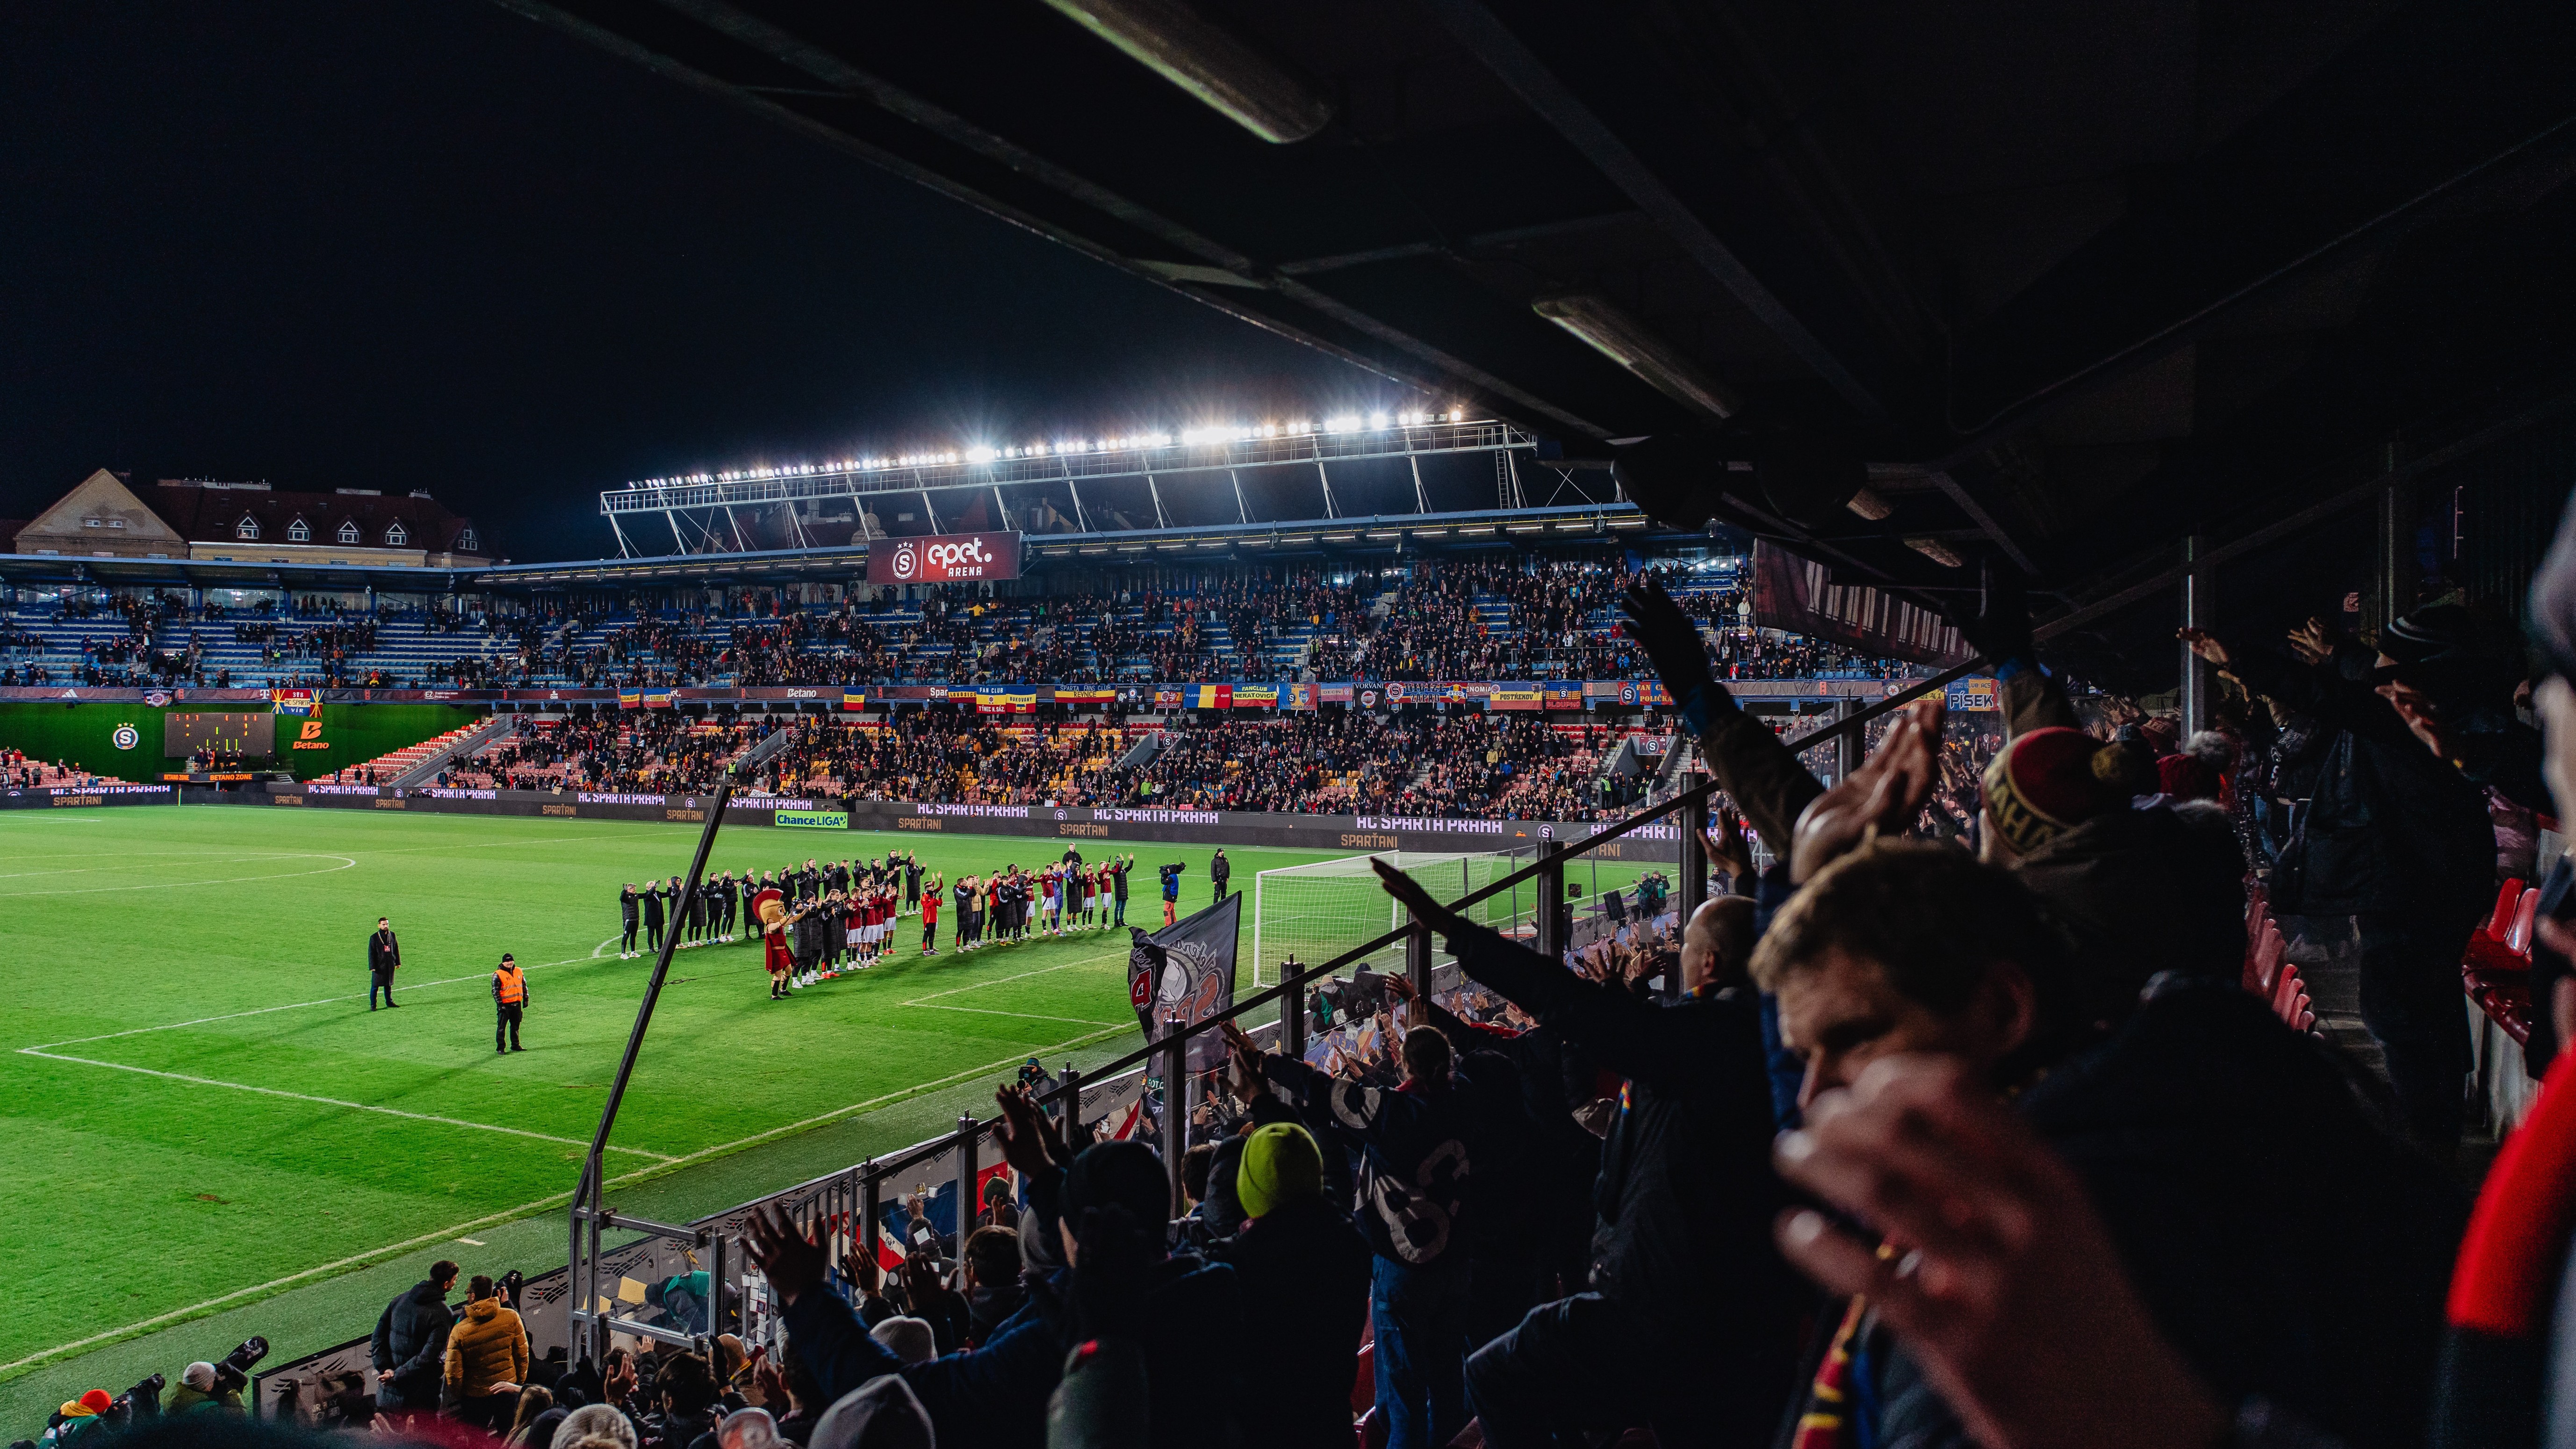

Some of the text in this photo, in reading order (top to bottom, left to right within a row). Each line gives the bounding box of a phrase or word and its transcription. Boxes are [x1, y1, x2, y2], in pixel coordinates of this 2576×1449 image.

[948, 566, 982, 577] ARENA
[787, 688, 817, 698] Betano
[1404, 683, 1446, 693] DIVIZE
[1410, 692, 1440, 702] ZÁPAD
[1950, 691, 1994, 709] PÍSEK
[53, 794, 101, 806] SPARŤANI
[275, 794, 302, 805] SPARŤANI
[375, 798, 405, 808] SPARŤANI
[543, 803, 576, 815] SPARŤANI
[667, 808, 704, 821] SPARŤANI
[777, 815, 840, 826] Chance LIGA
[898, 816, 942, 829] SPARŤANI
[1060, 822, 1108, 836] SPARŤANI
[1341, 833, 1397, 848] SPARŤANI
